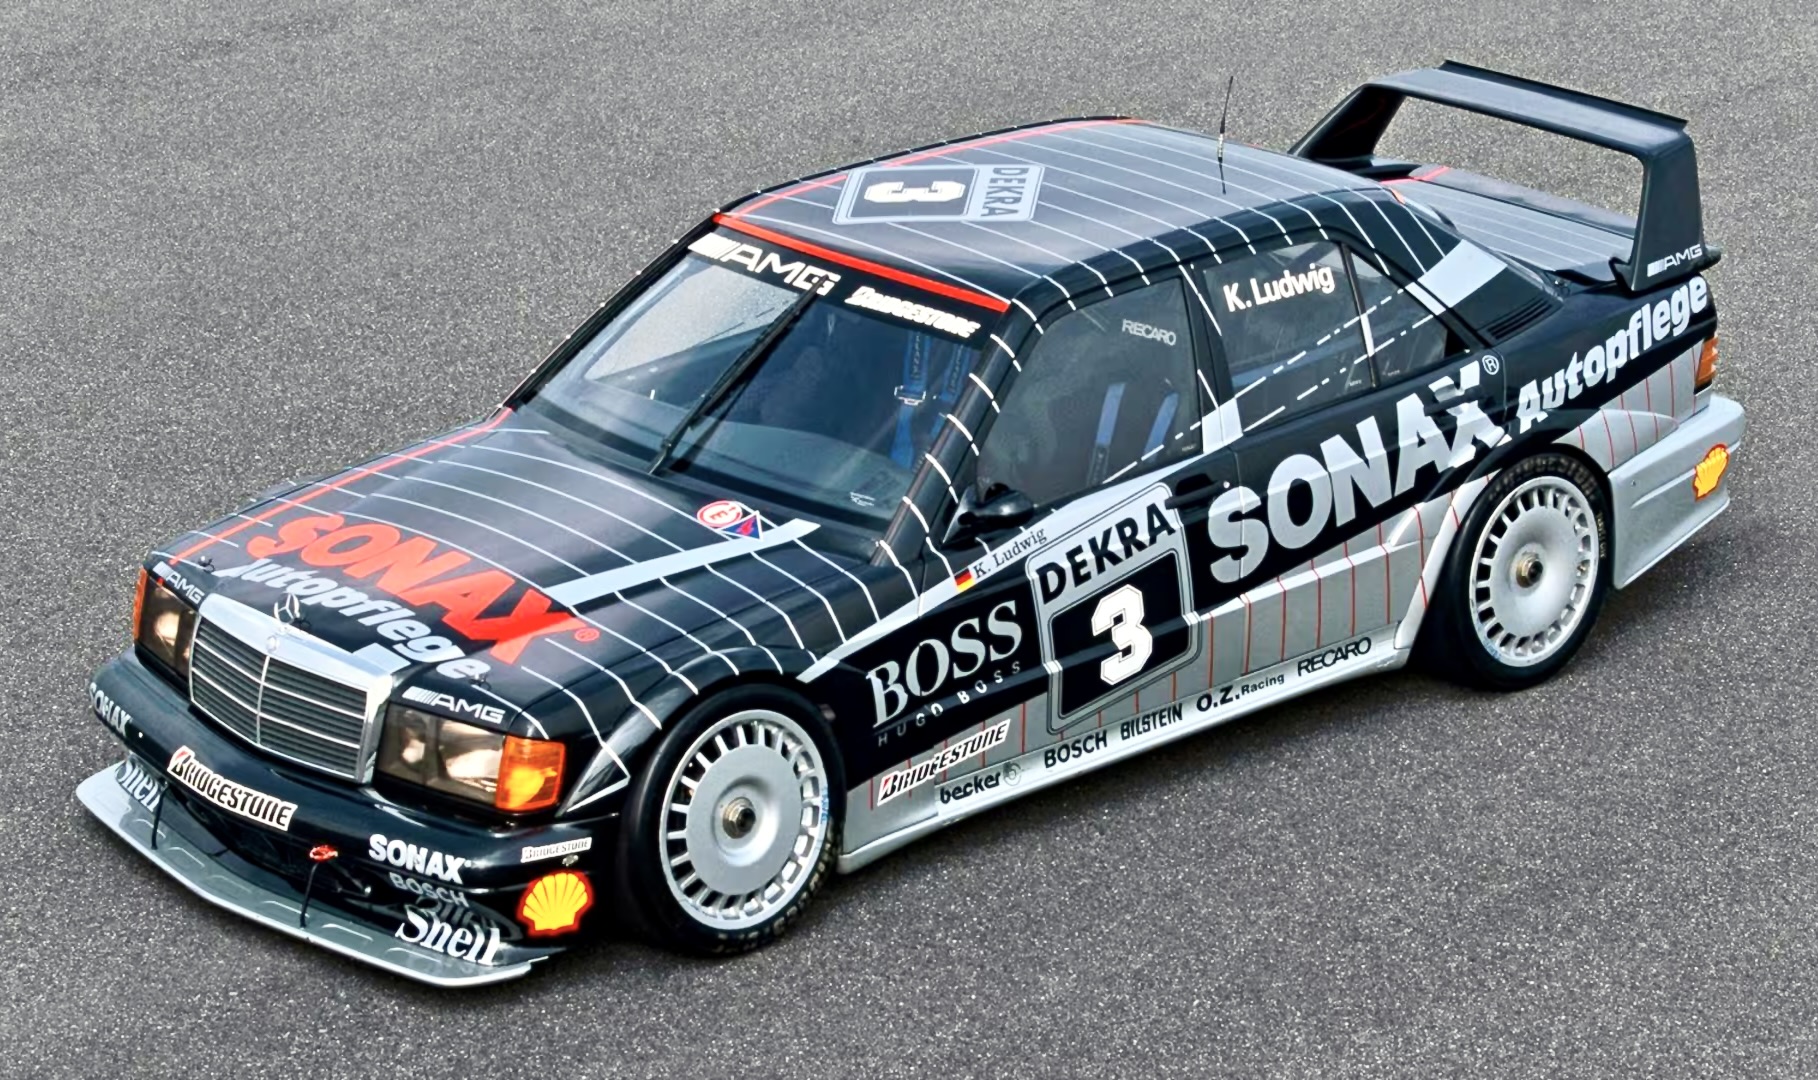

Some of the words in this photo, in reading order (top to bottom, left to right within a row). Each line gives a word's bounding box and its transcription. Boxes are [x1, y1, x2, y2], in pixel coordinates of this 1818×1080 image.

[864, 181, 966, 204] 3
[981, 167, 1030, 217] DEKRA
[720, 243, 841, 296] AMG
[1663, 243, 1703, 270] AMG
[1223, 283, 1253, 312] K.
[1251, 263, 1336, 305] Ludwig
[1122, 319, 1177, 346] RECARO
[1517, 276, 1707, 434] Autopflege
[1208, 361, 1513, 583] SONAX
[973, 565, 992, 580] K.
[992, 528, 1048, 567] Ludwig
[1036, 503, 1176, 605] DEKRA
[166, 573, 205, 604] AMG
[246, 514, 587, 665] SONAX
[211, 558, 491, 679] Autopflege
[1091, 584, 1153, 686] 3
[866, 600, 1022, 728] BOSS
[1298, 637, 1372, 676] RECARO
[89, 682, 131, 737] SONAX
[432, 695, 505, 723] AMG
[878, 703, 943, 747] HUGO
[957, 661, 1020, 704] BOSS
[1120, 703, 1183, 740] BILSTEIN
[880, 722, 1008, 800] BRIDGESTONE
[1044, 730, 1107, 768] BOSCH
[173, 751, 292, 828] BRIDGESTONE
[940, 773, 1001, 804] becker
[369, 834, 467, 885] SONAX
[390, 872, 469, 907] BOSCH
